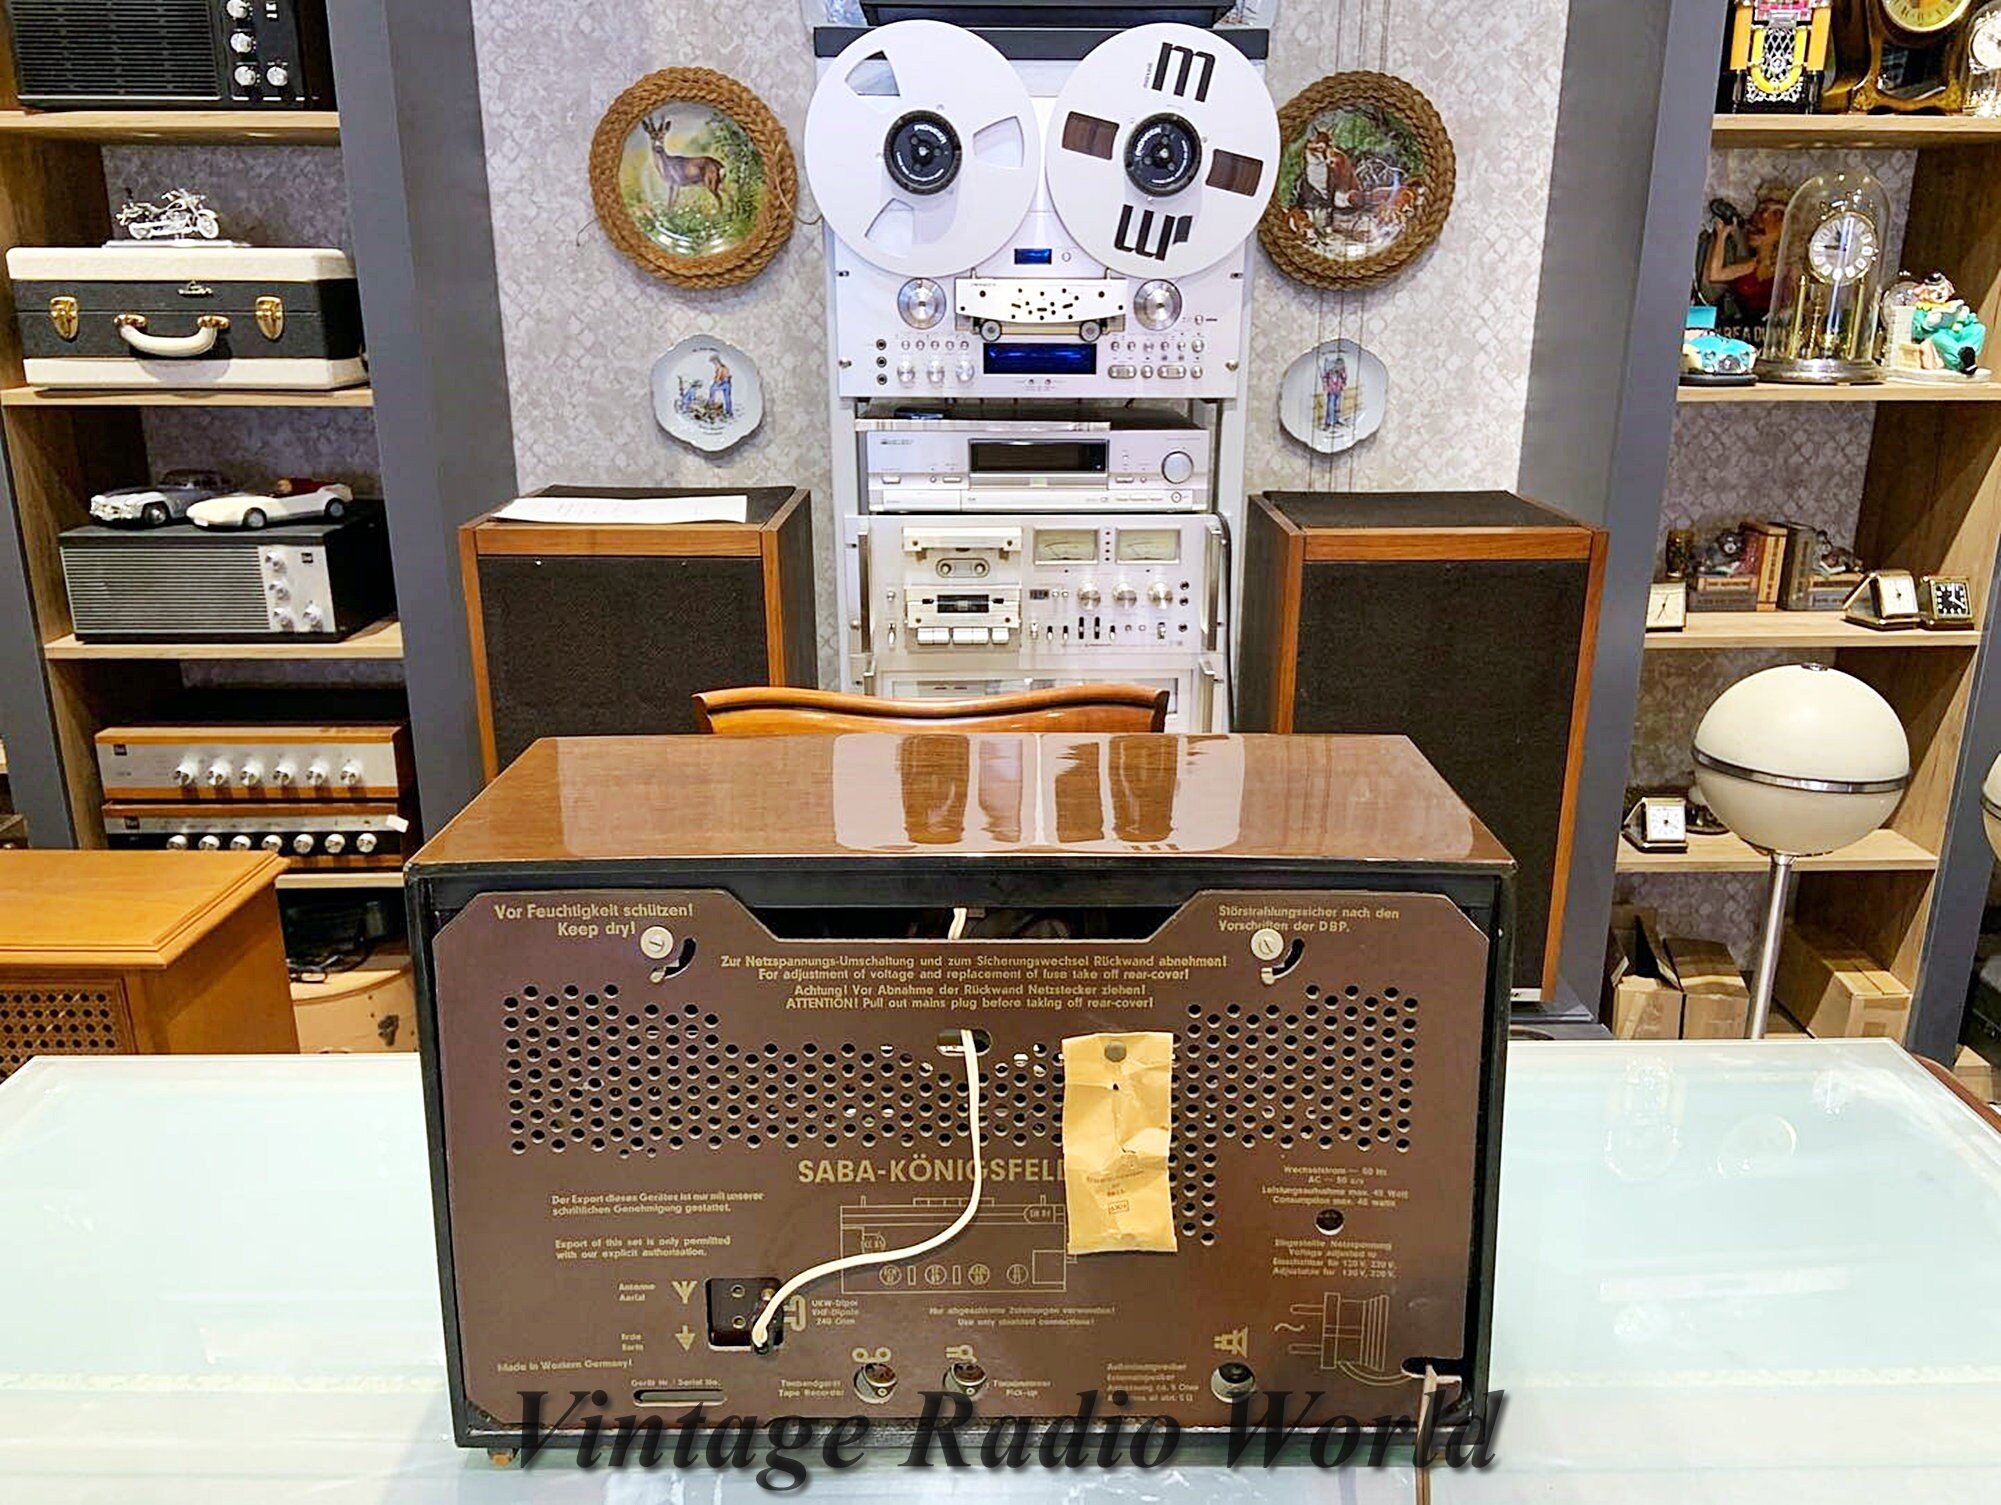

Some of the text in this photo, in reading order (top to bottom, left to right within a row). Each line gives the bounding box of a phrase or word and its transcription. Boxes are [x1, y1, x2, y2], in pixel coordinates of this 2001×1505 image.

[494, 902, 694, 920] Vor Feuchtigkeit schützen!
[1343, 907, 1371, 919] nach
[1375, 907, 1400, 920] den
[557, 920, 636, 938] Keep dry!
[1293, 920, 1316, 932] der
[721, 955, 1228, 969] Zur Netzspannungs-Umschaltung und zum Sicherungswechsel Rückwand abnehmen!
[758, 968, 1190, 982] For adjustment of voltage and replacement of fuse take off rear-cover!
[793, 984, 1146, 998] Achtung! Vor Abnahme der Rückwand Netzstecker ziehen!
[785, 997, 1154, 1011] ATTENTION! Pull out mains plug before taking off rear-cover!
[552, 1195, 570, 1205] Der
[571, 1194, 604, 1206] Export
[613, 1203, 682, 1215] Genehmigung
[555, 1239, 588, 1250] Export
[592, 1238, 602, 1248] of
[606, 1238, 623, 1247] this
[627, 1238, 643, 1247] set
[658, 1236, 680, 1248] only
[684, 1235, 731, 1247] permitted
[556, 1250, 577, 1260] with
[581, 1250, 598, 1259] our
[602, 1249, 638, 1260] explicit
[497, 1357, 633, 1372] Made in Western Germany!
[779, 1389, 845, 1399] Tape Recorder
